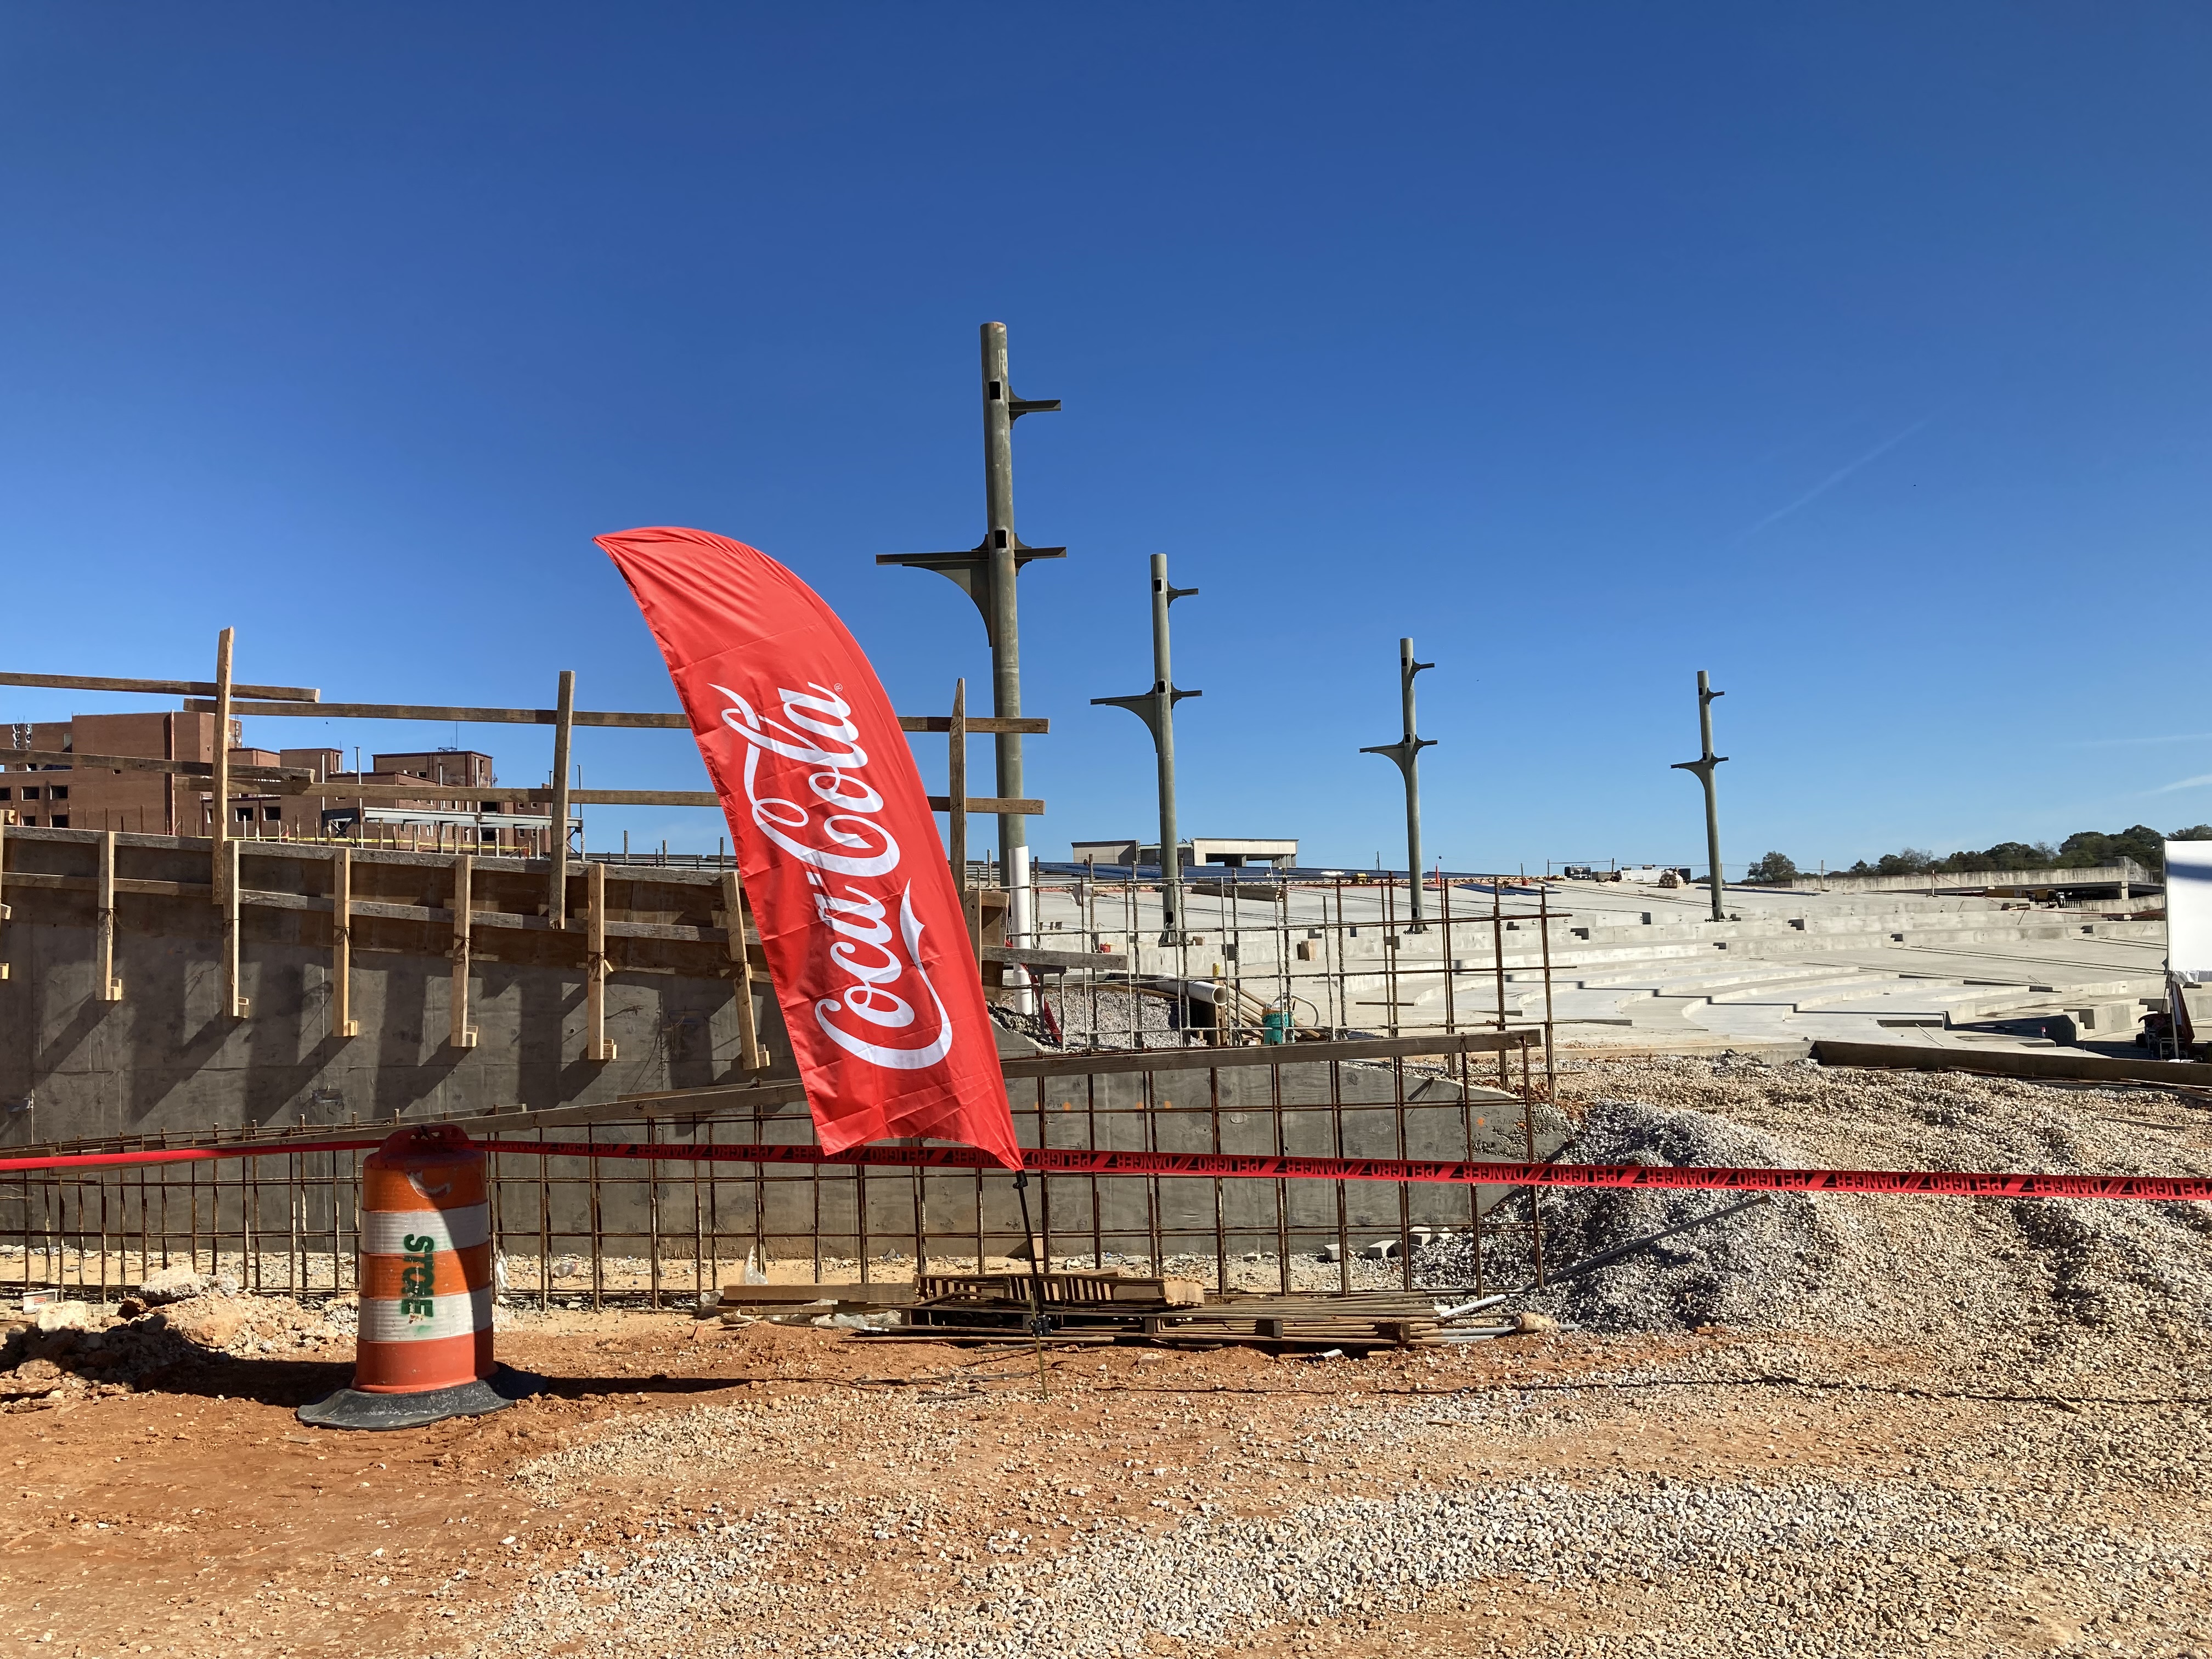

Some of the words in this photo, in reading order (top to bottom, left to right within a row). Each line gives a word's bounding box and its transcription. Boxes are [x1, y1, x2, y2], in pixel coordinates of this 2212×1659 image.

[707, 681, 952, 1070] Coca-Cola
[636, 1144, 689, 1156] DANGER
[712, 1145, 768, 1158] PELIGRO
[870, 1148, 928, 1163] PELIGRO
[952, 1150, 999, 1165] ANGER
[1031, 1152, 1091, 1167] PELIGRO
[1117, 1154, 1172, 1170] DANGER
[1198, 1156, 1259, 1173] PELIGRO
[1286, 1159, 1344, 1175] DANGER
[1371, 1163, 1435, 1178] PELIGRO
[1463, 1165, 1523, 1180] DANGER
[1551, 1167, 1617, 1183] PELIGRO
[1646, 1169, 1708, 1185] DANGER
[1737, 1172, 1805, 1187] PELIGRO
[1836, 1173, 1900, 1189] DANGER
[1930, 1176, 2002, 1191] PELIGRO
[2033, 1178, 2102, 1194] DANGER
[2132, 1180, 2208, 1196] PELIGRO
